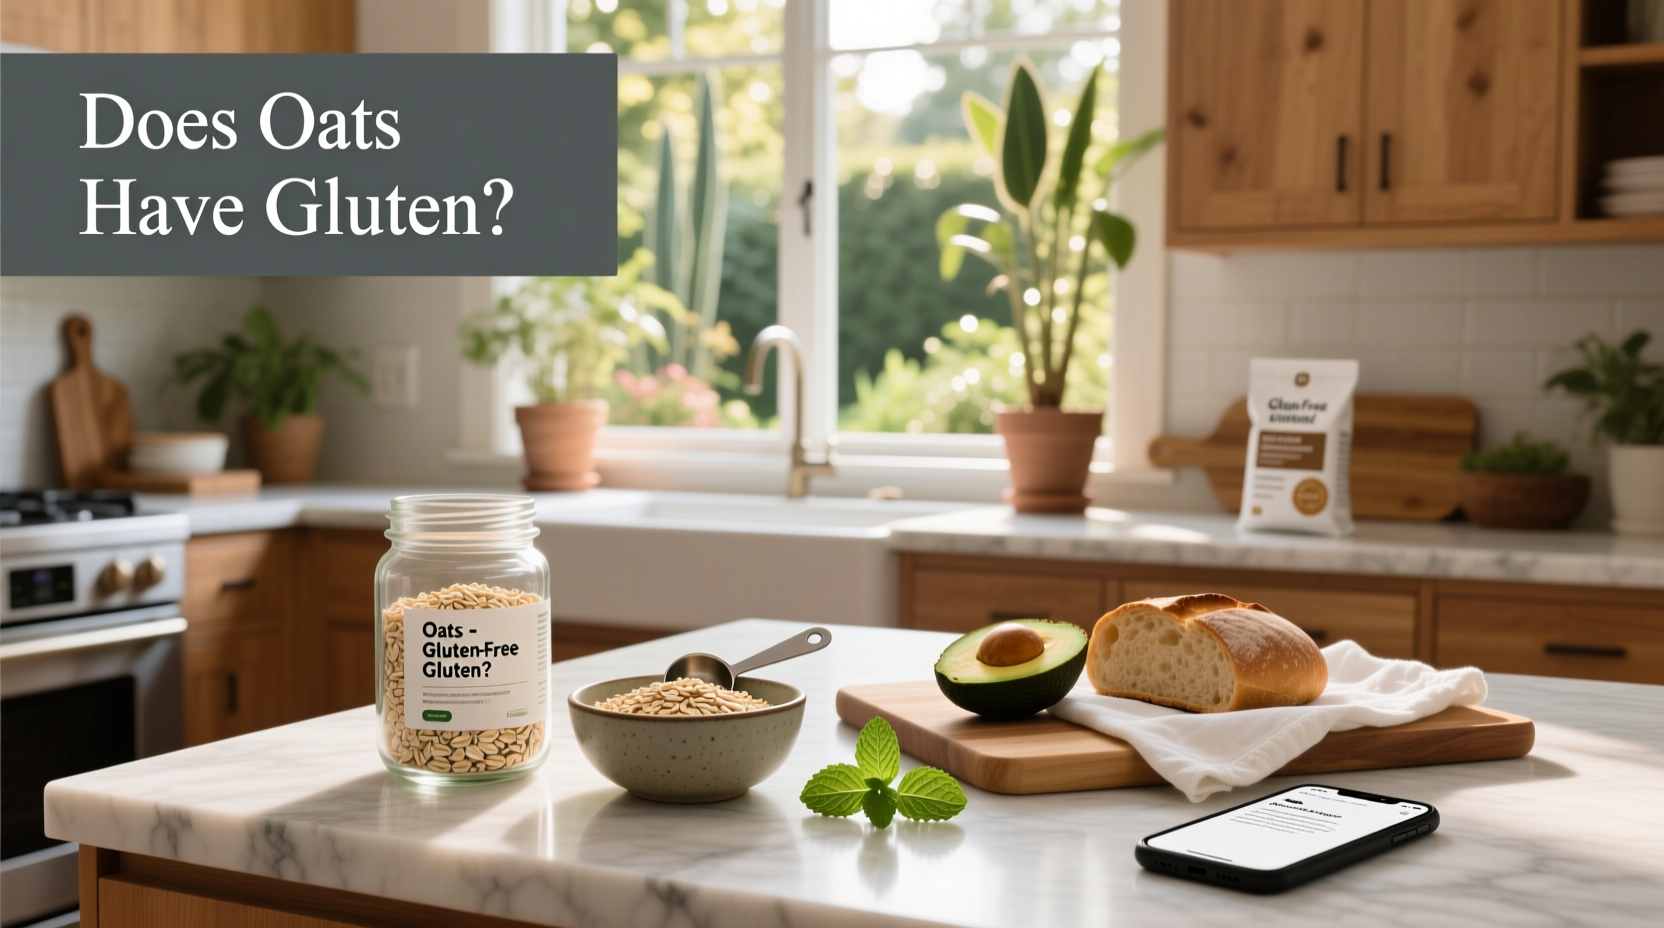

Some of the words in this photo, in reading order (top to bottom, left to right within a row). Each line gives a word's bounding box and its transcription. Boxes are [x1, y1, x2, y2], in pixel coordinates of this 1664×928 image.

[422, 621, 463, 638] Oats
[422, 641, 519, 658] Gluten-Free
[422, 661, 492, 678] Gluten?
